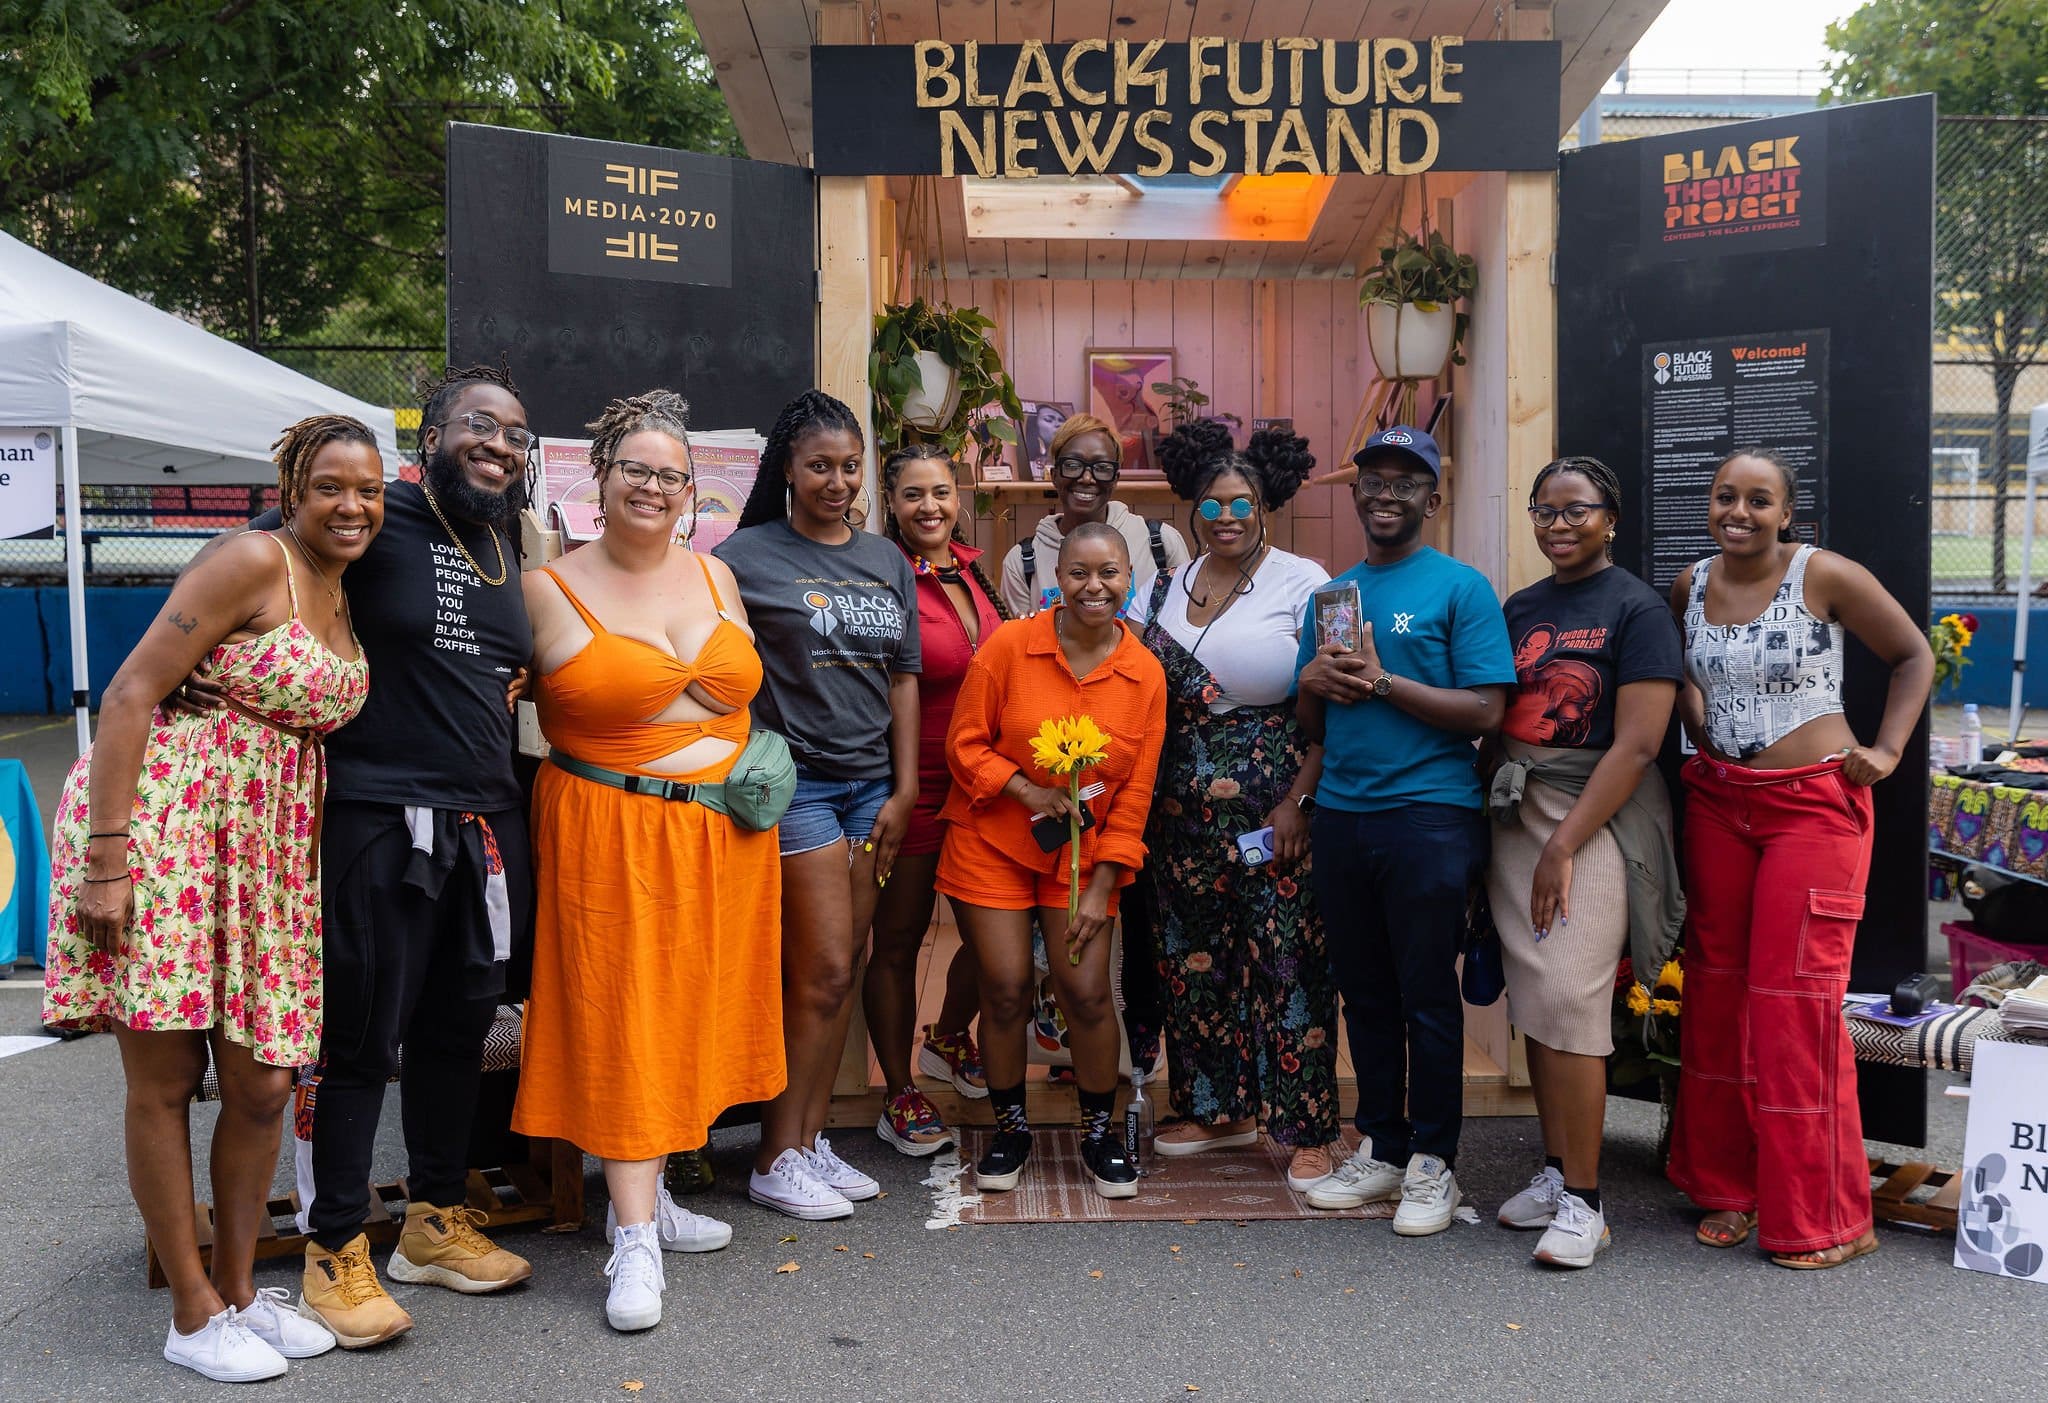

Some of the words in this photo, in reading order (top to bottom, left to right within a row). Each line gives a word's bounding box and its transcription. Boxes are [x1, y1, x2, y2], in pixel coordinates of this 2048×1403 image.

[914, 37, 1168, 108] BLACK
[1188, 35, 1464, 106] FUTURE
[1664, 136, 1800, 184] BLACK
[1664, 168, 1800, 205] THOUGHT
[1664, 190, 1800, 229] PROJECT
[1663, 231, 1705, 242] CENTERING
[1708, 229, 1722, 237] THE
[1724, 225, 1749, 235] BLACK
[1751, 220, 1800, 232] EXPERIENCE
[1673, 350, 1712, 365] BLACK
[1731, 343, 1807, 360] Welcome!
[1673, 363, 1712, 375] FUTURE
[1673, 374, 1712, 382] NEWSSTAND
[430, 543, 463, 558] LOVE
[433, 555, 474, 573] BLACK
[436, 568, 481, 588] PEOPLE
[437, 582, 464, 597] LIKE
[437, 596, 463, 610] YOU
[834, 595, 899, 612] BLACK
[437, 610, 467, 626] LOVE
[842, 610, 902, 629] FUTURE
[435, 624, 475, 641] BLACK
[844, 625, 902, 640] NEWSSTAND
[434, 638, 481, 656] CXFFEE
[1562, 638, 1605, 649] PROBLEM!
